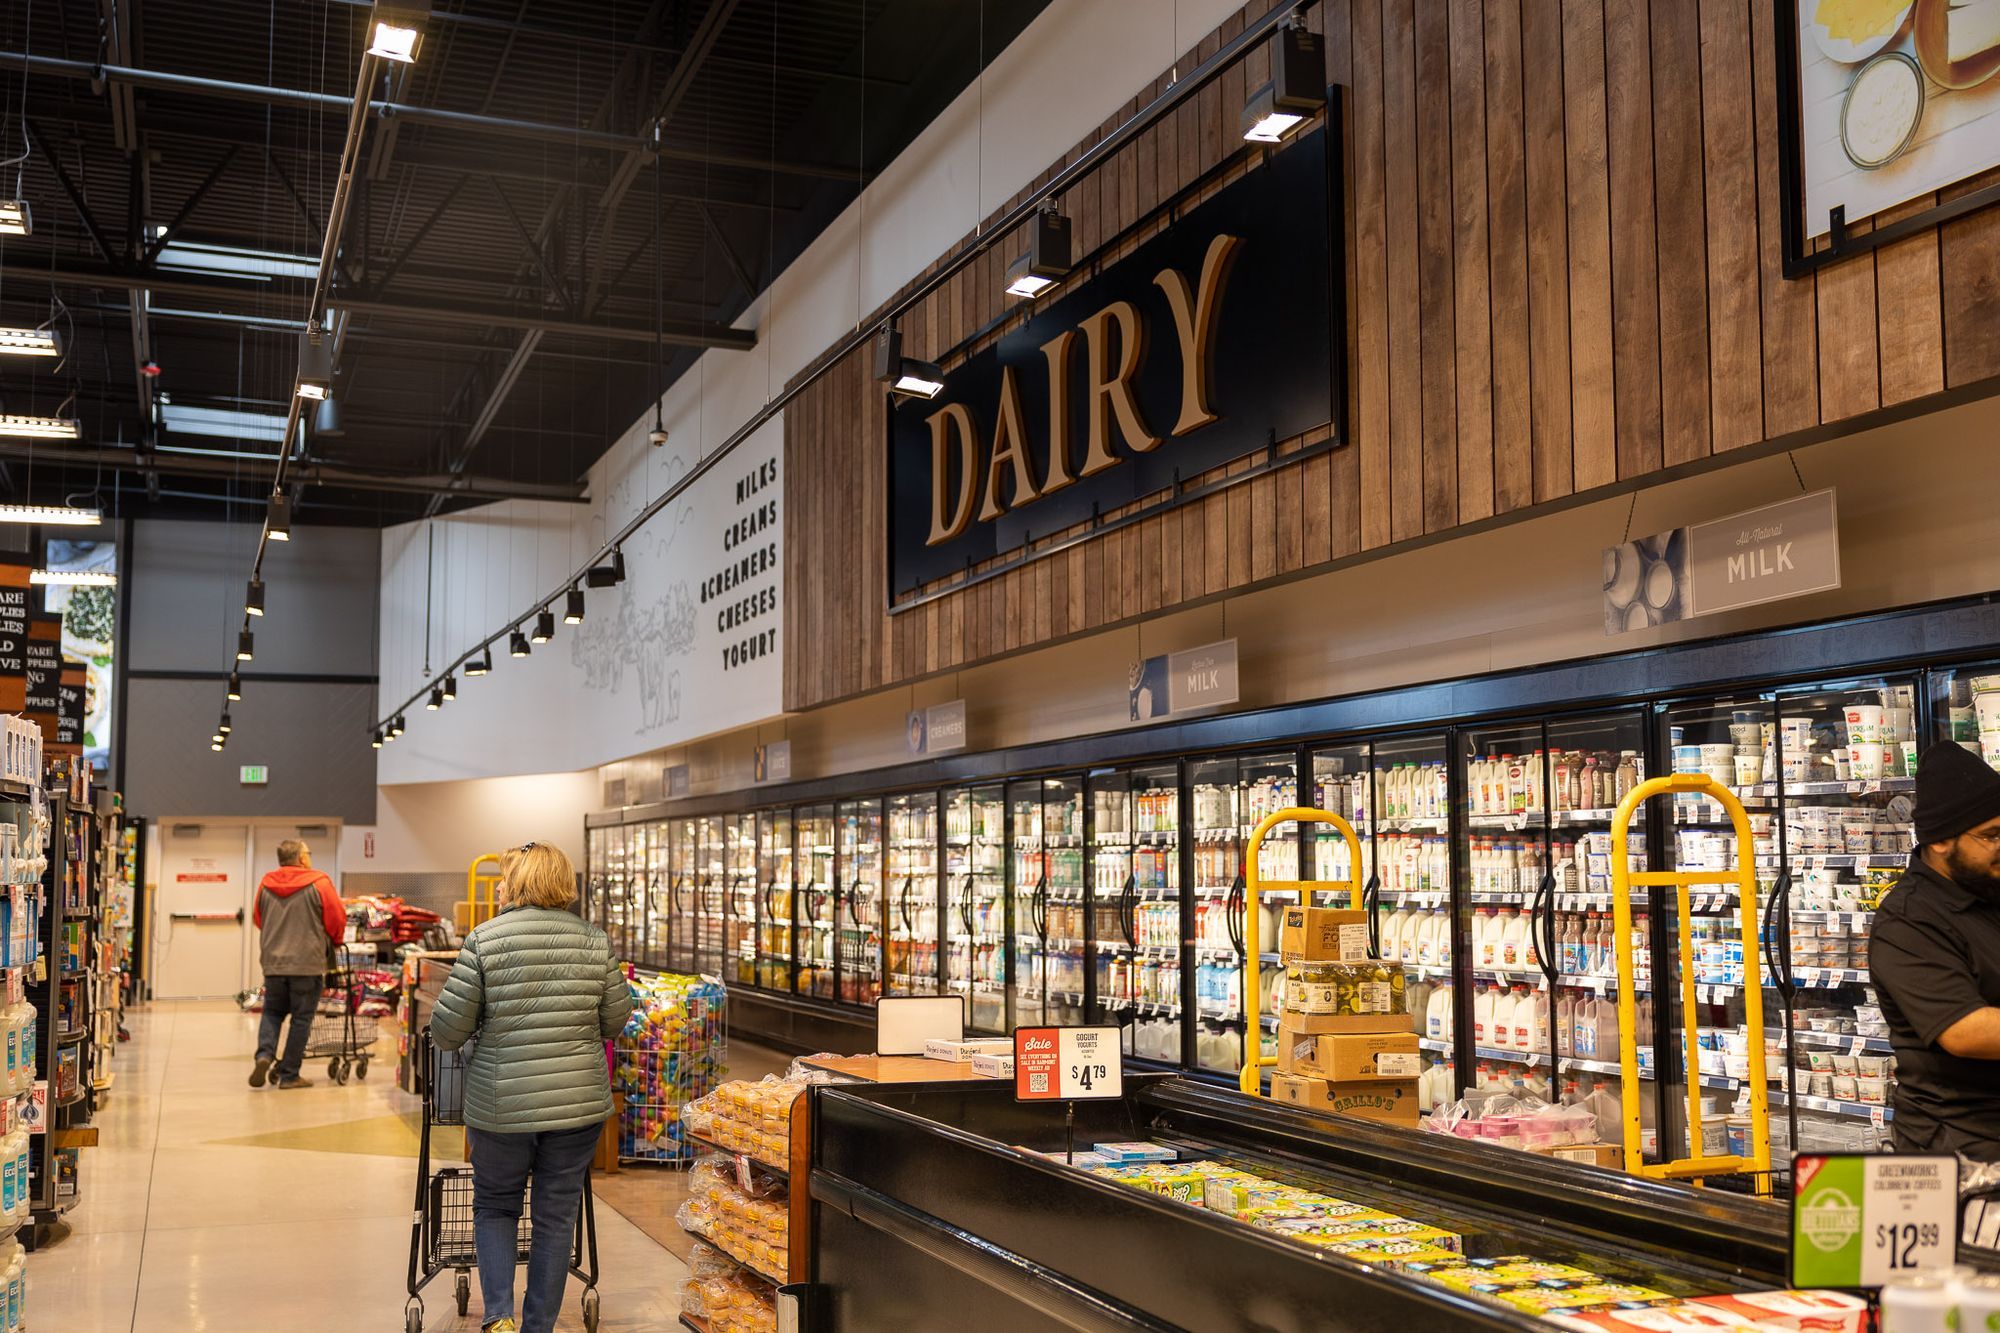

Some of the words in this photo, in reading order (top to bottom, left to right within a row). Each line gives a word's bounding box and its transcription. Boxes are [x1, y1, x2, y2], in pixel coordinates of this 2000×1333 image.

[924, 234, 1237, 546] DAIRY
[737, 457, 776, 505] MILKS
[724, 500, 776, 551] CREAMS
[1728, 541, 1794, 584] MILK
[0, 606, 26, 618] LIES
[718, 586, 776, 633] CHEESES
[723, 628, 776, 671] YOGURT
[1188, 670, 1218, 693] MILK
[1024, 1037, 1053, 1052] Sale
[1334, 1095, 1394, 1112] GRILLO'S
